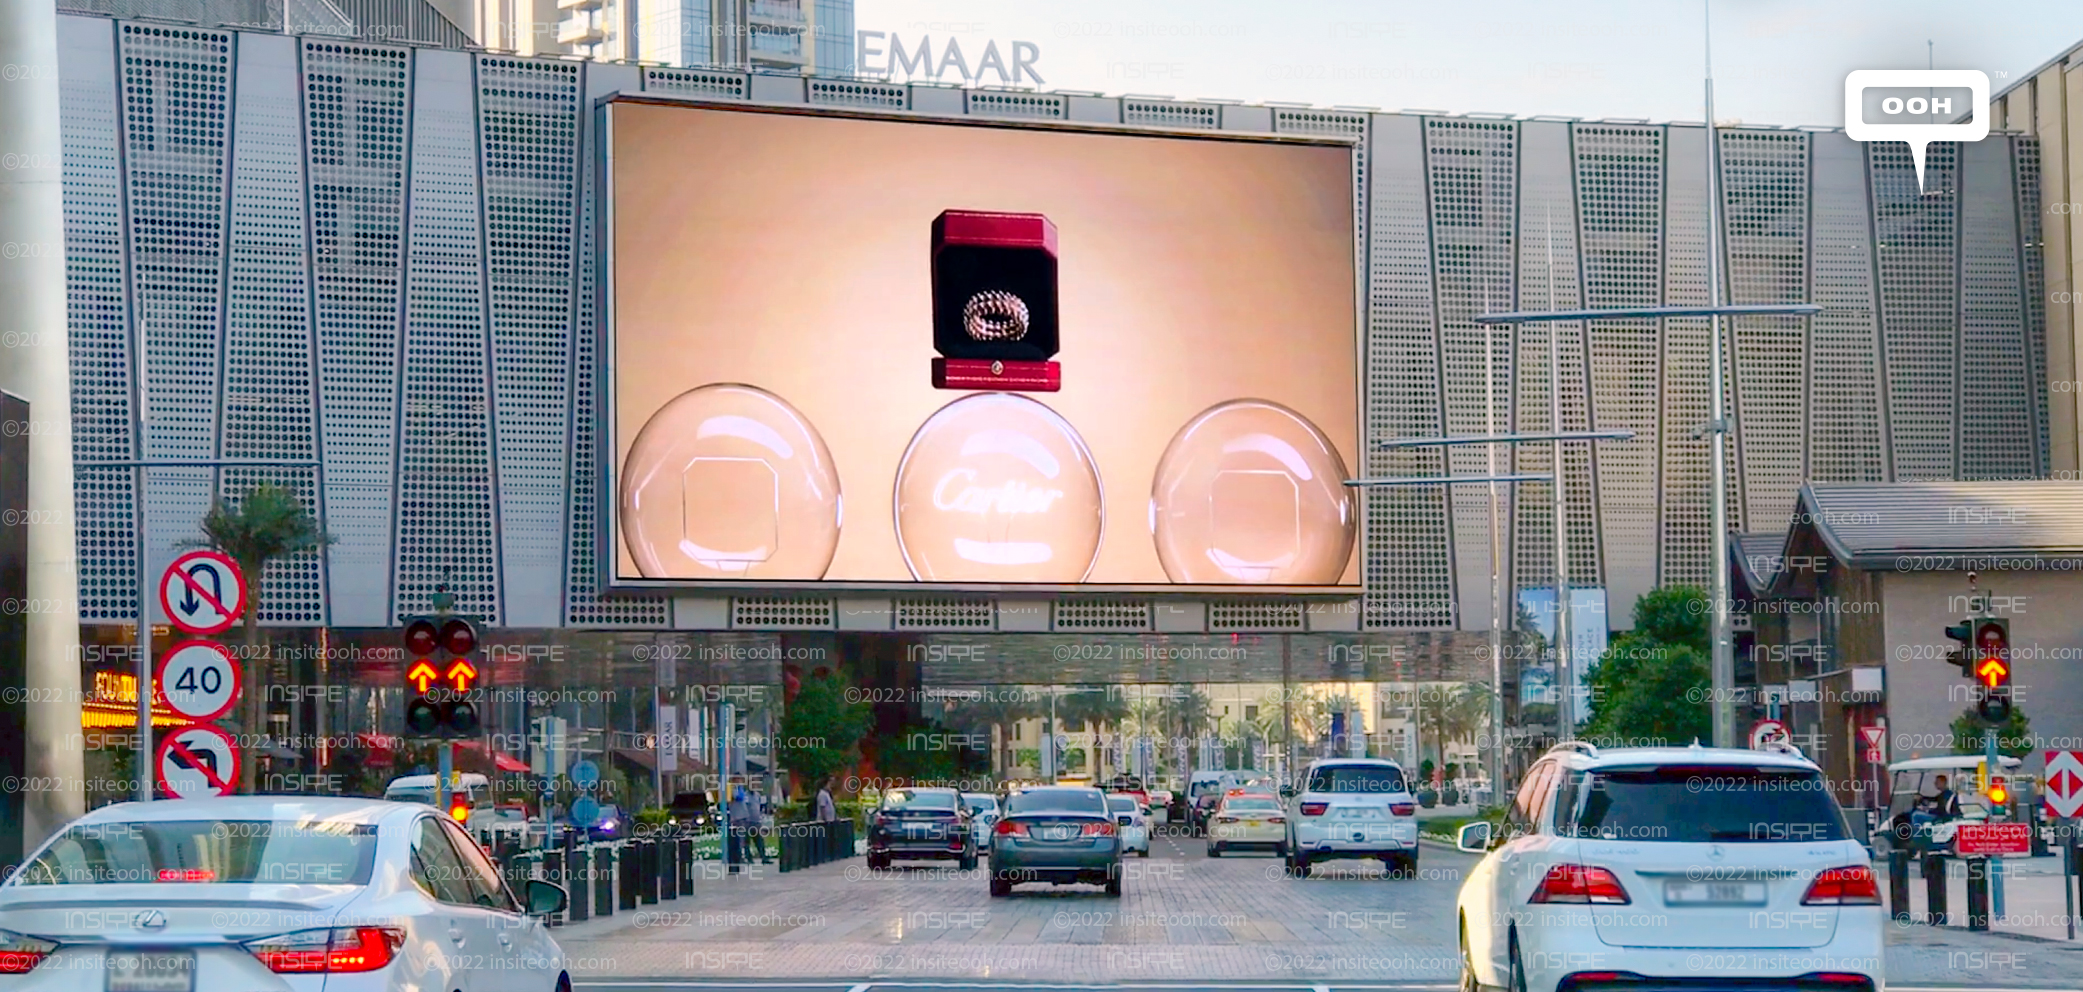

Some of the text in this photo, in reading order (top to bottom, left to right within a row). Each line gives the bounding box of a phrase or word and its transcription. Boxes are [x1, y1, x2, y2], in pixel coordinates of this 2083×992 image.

[858, 30, 1044, 84] EMAAR
[933, 467, 1064, 514] Cartier
[175, 666, 222, 695] 40
